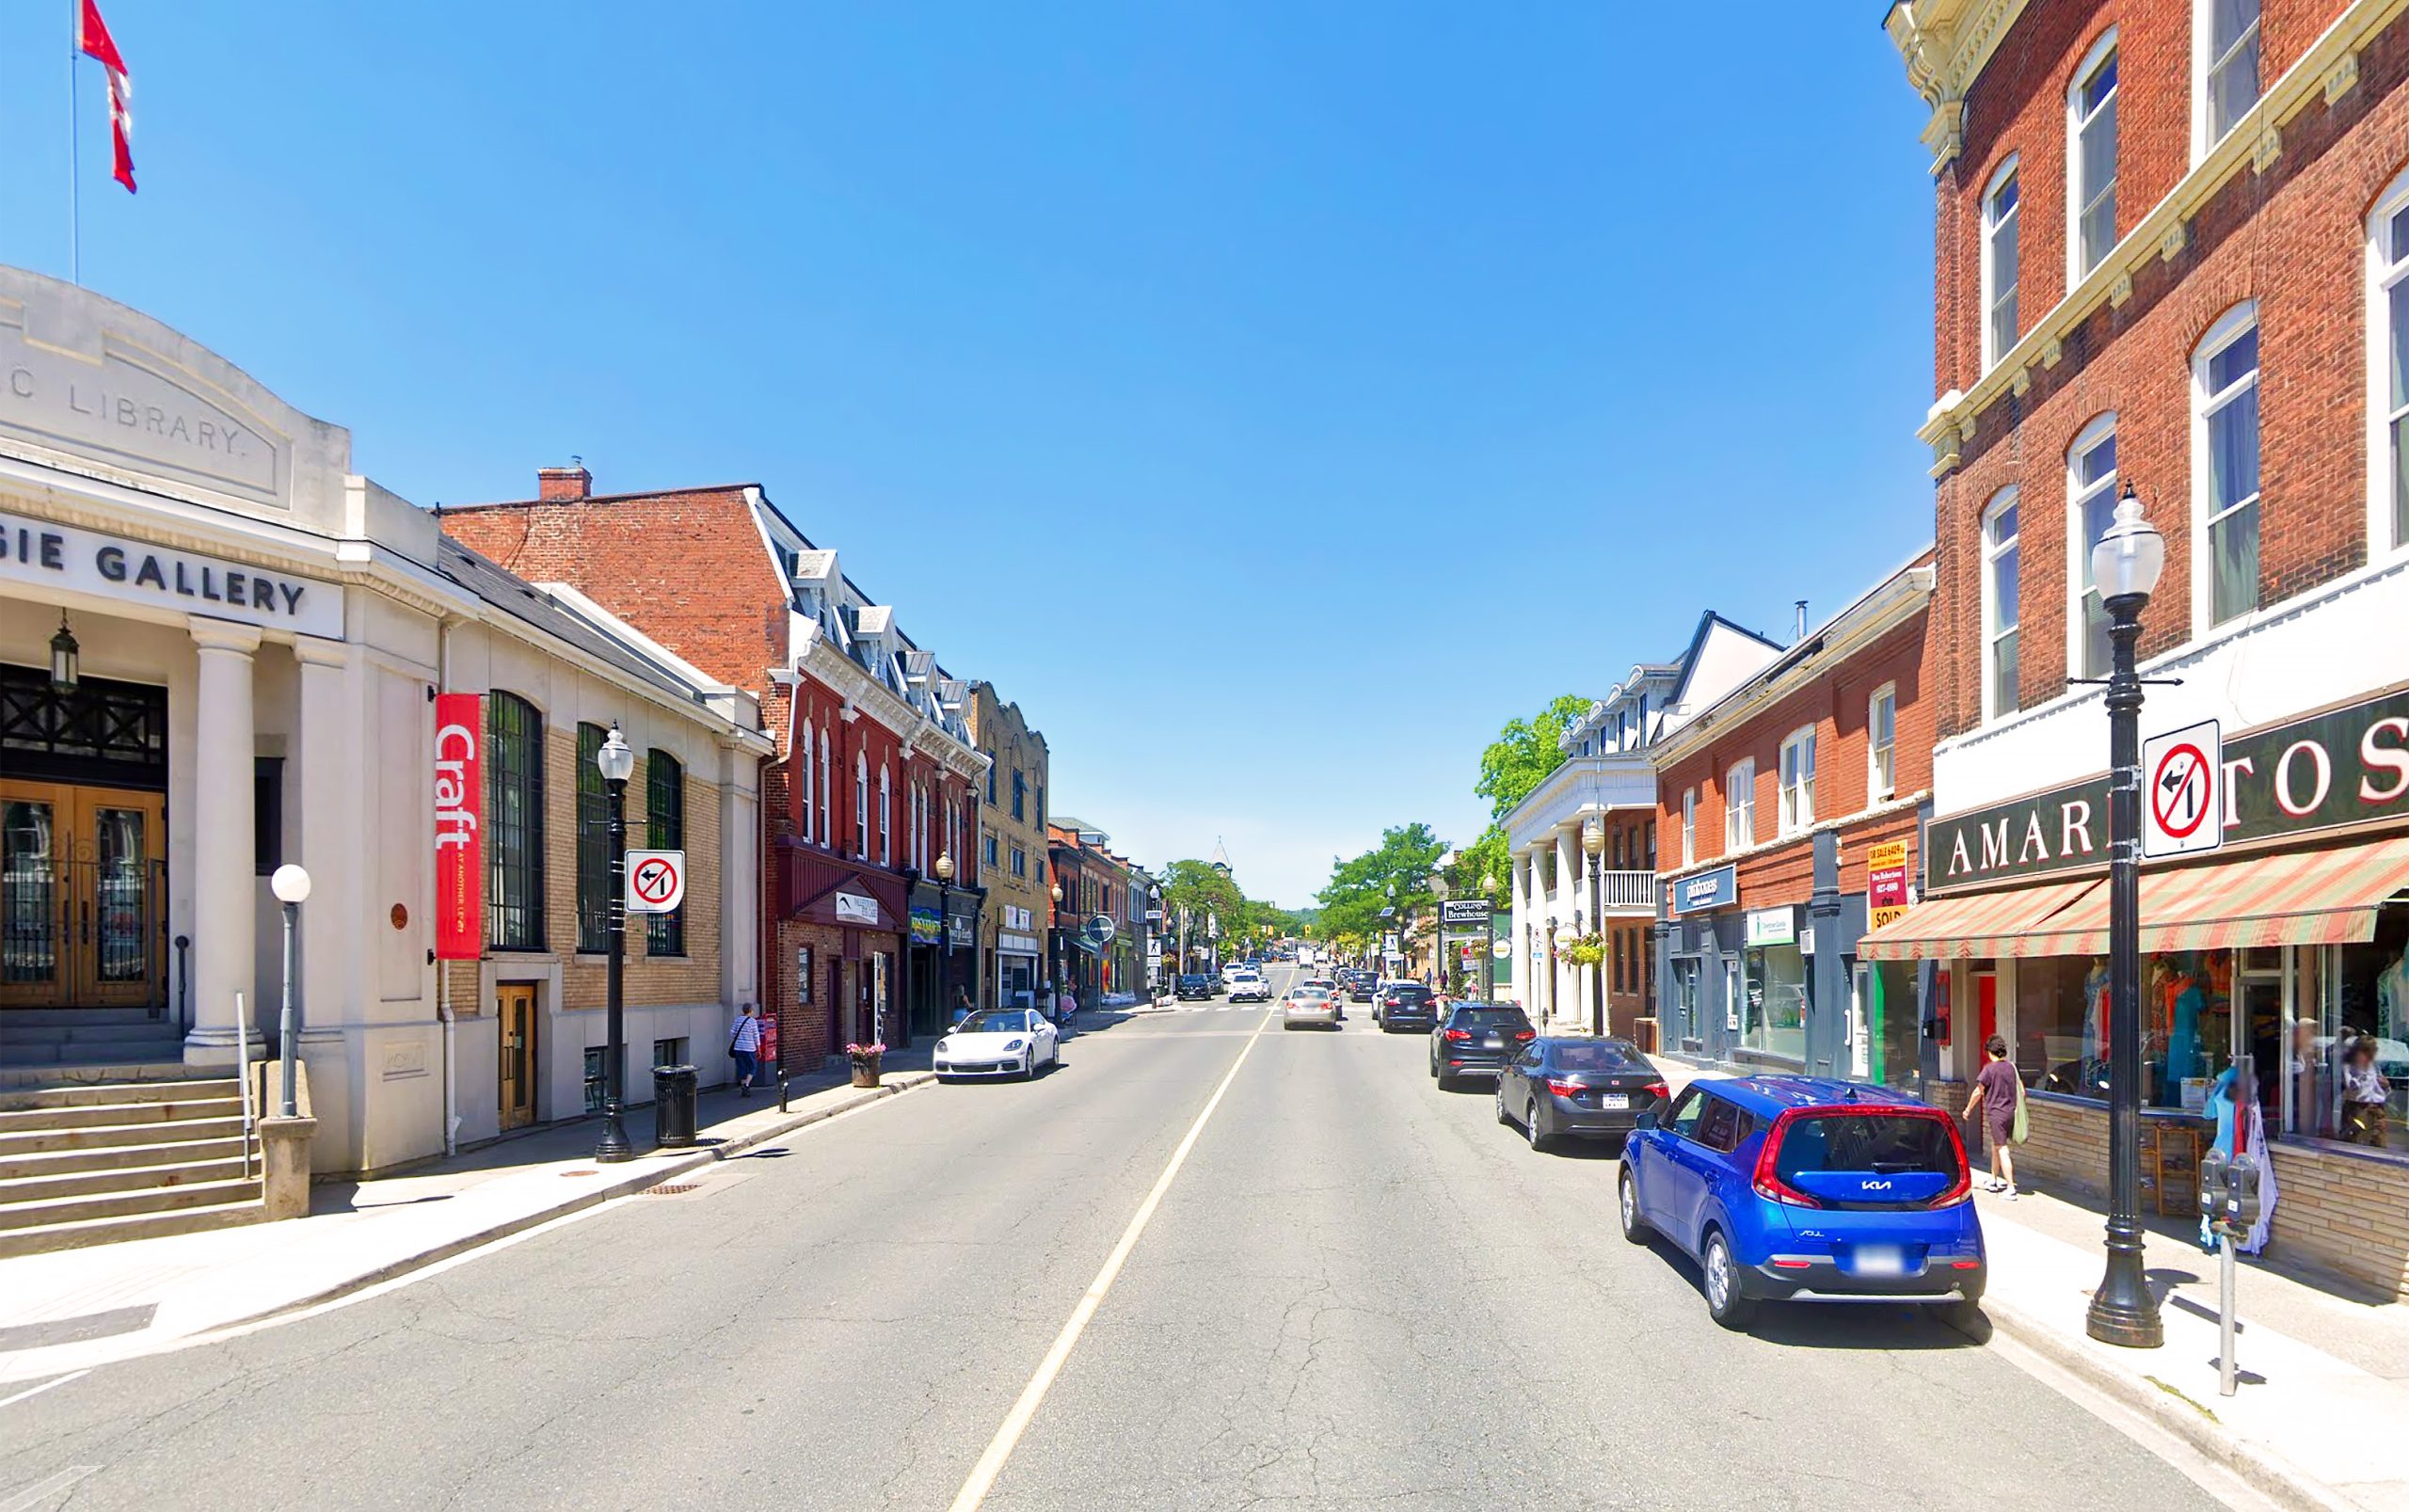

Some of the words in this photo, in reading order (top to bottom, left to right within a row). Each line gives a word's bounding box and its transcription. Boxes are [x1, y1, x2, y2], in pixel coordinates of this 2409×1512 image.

[0, 524, 64, 571] IE
[95, 546, 305, 615] GALLERY
[436, 724, 477, 850] Craft
[1876, 848, 1887, 858] SALE
[1447, 910, 1489, 918] Brewhouse
